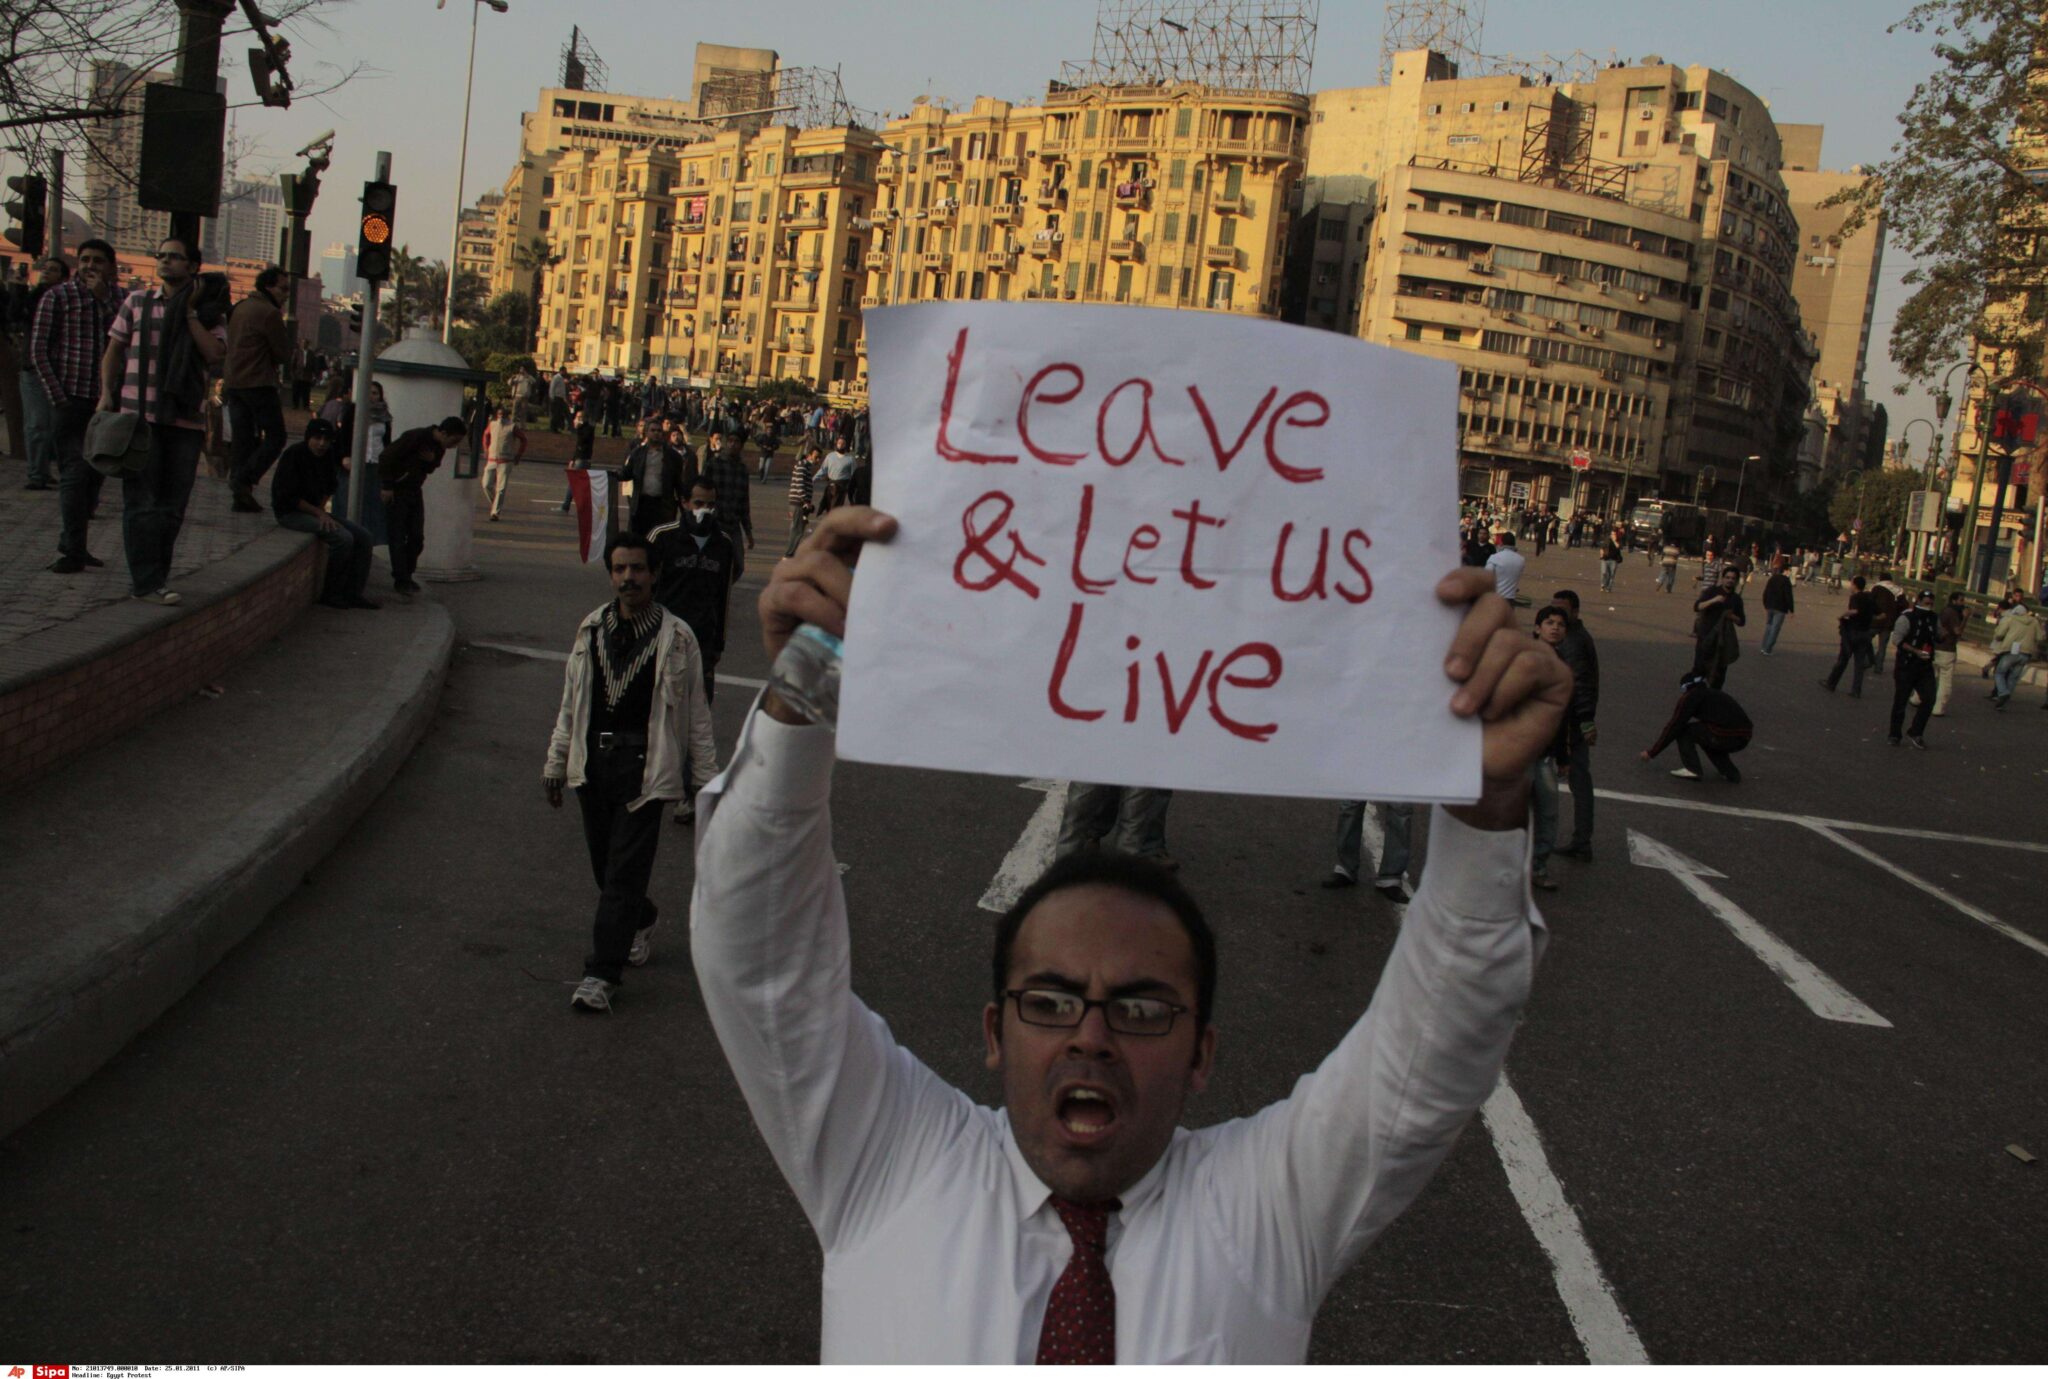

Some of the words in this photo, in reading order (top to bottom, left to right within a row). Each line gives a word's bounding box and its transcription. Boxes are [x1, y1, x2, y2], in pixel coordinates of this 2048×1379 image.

[935, 327, 1331, 483] Leave
[1271, 519, 1375, 604] us
[1047, 602, 1283, 742] Live
